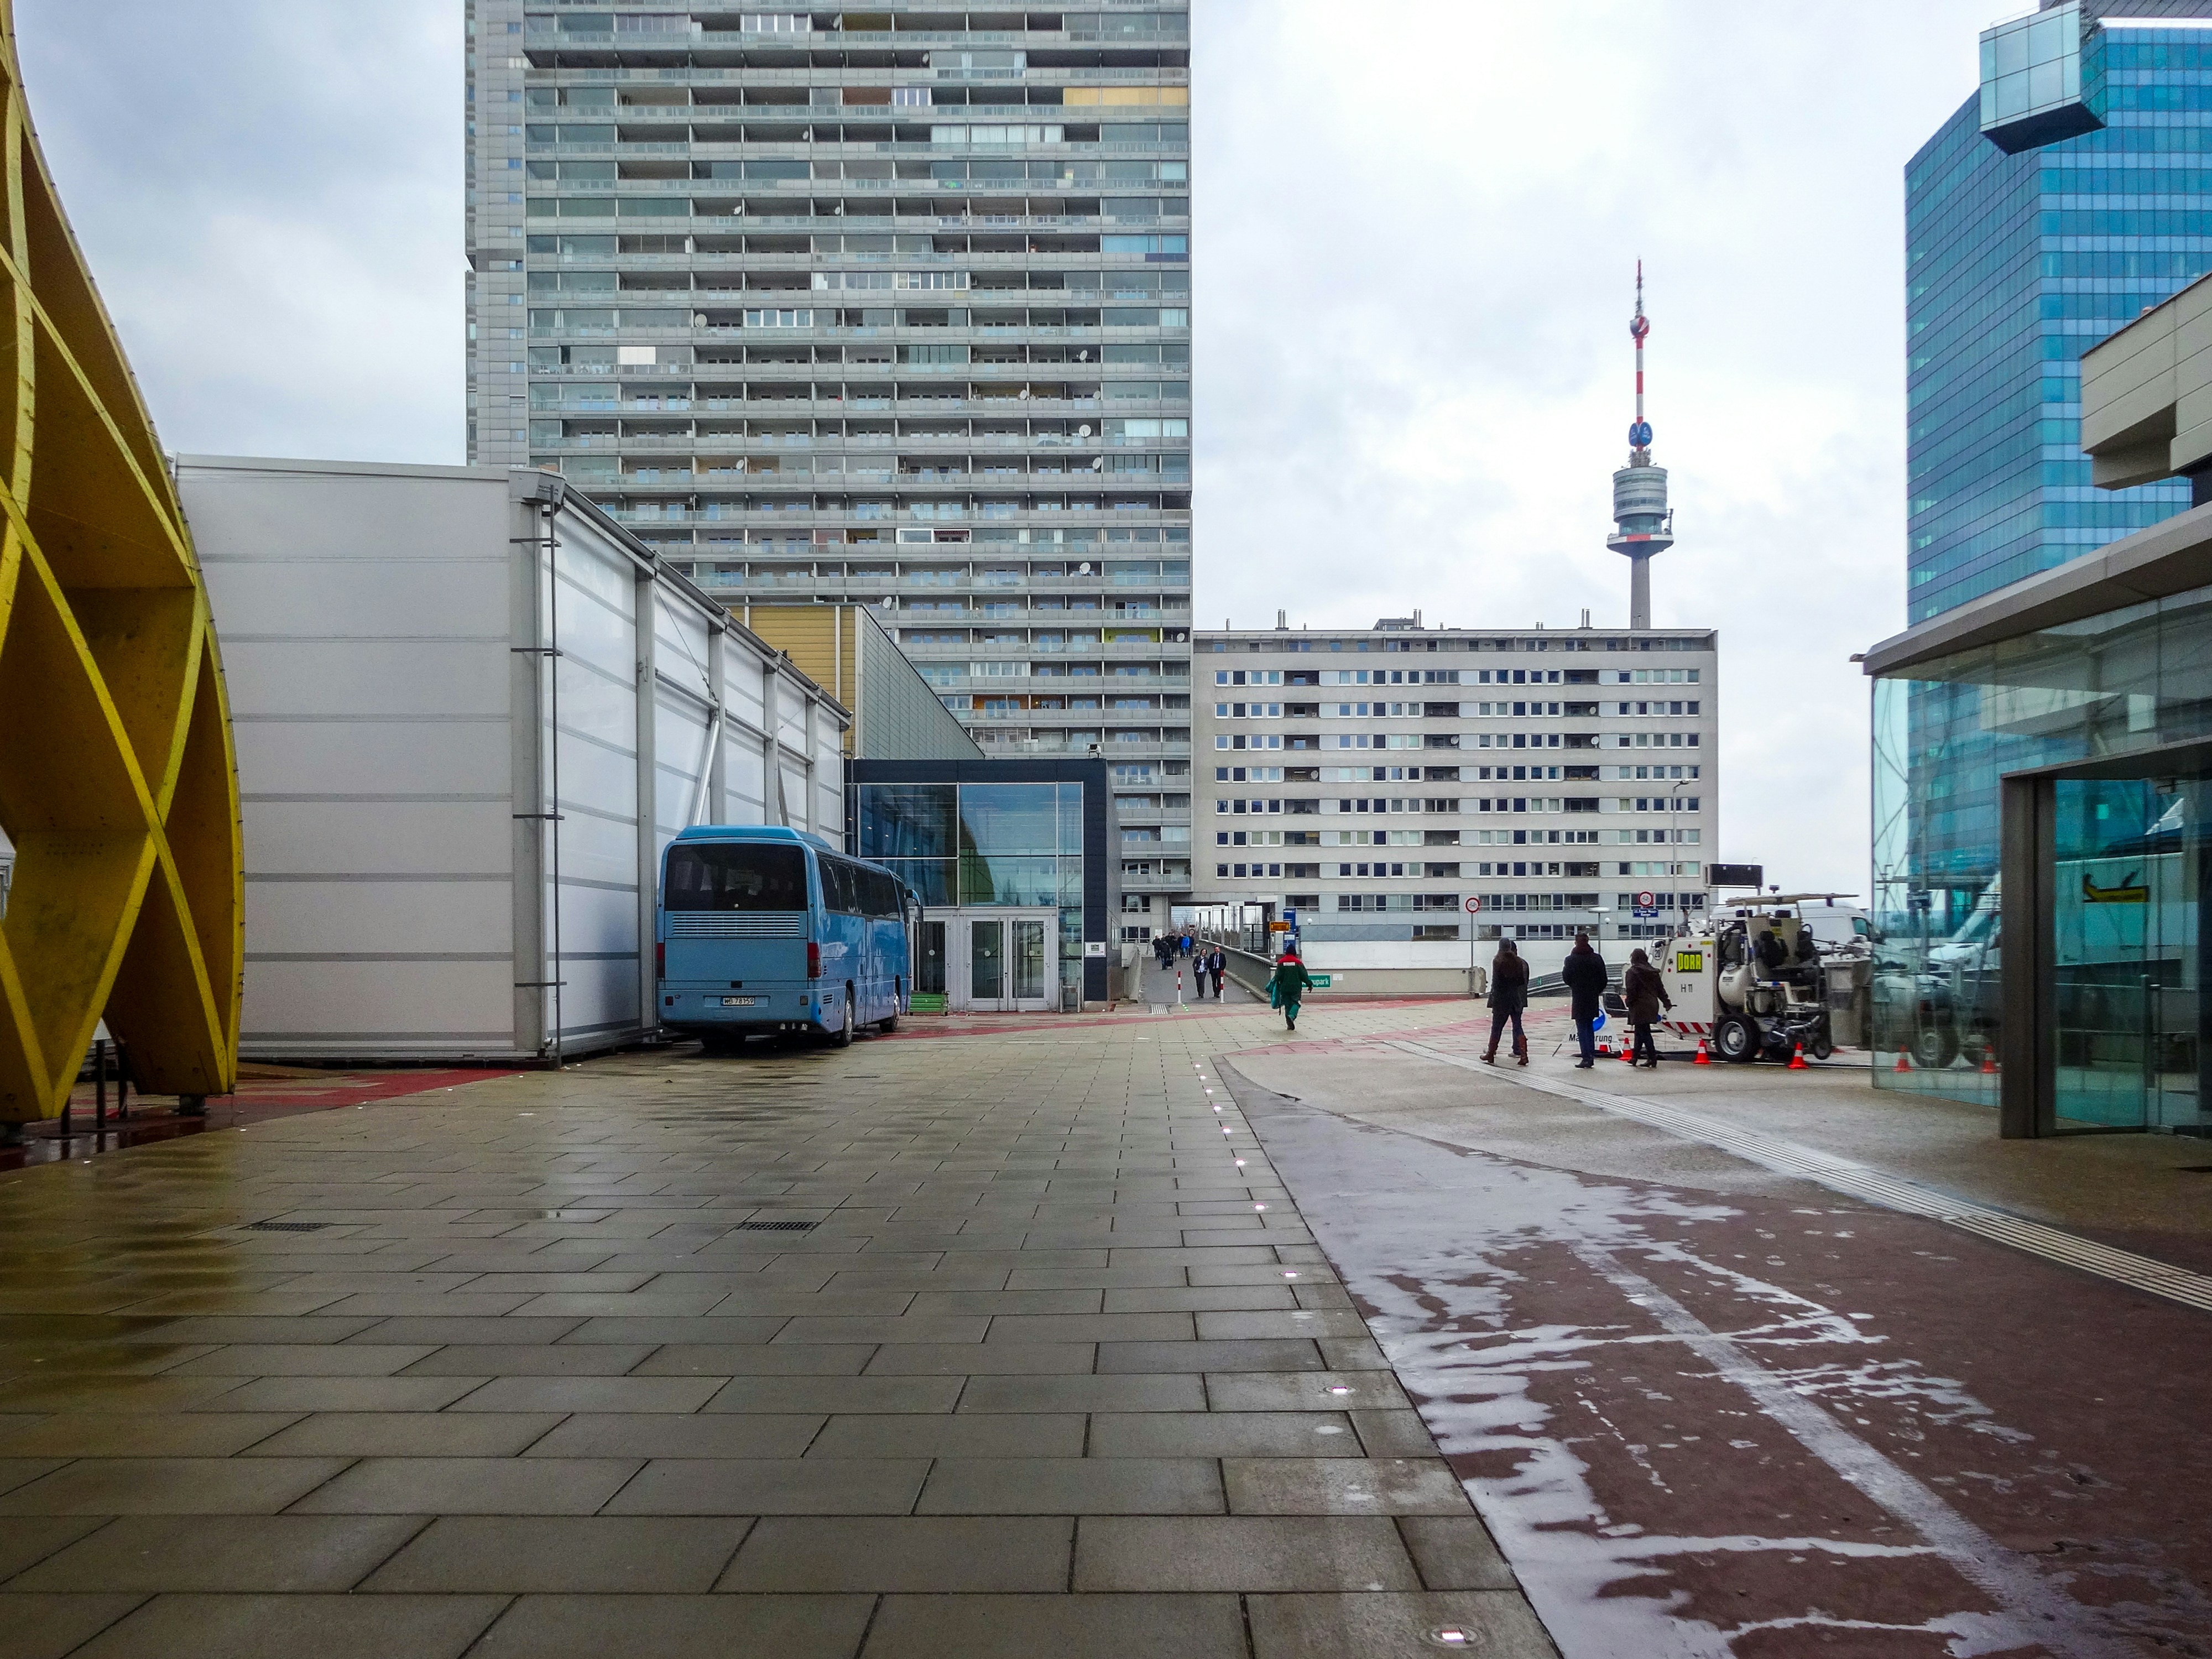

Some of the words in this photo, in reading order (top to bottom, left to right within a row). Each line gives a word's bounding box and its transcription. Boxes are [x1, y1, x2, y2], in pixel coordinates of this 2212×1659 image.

[1655, 949, 1661, 958] 20
[1677, 953, 1702, 971] PORR
[1681, 984, 1686, 993] H
[1569, 1034, 1613, 1044] Marung
